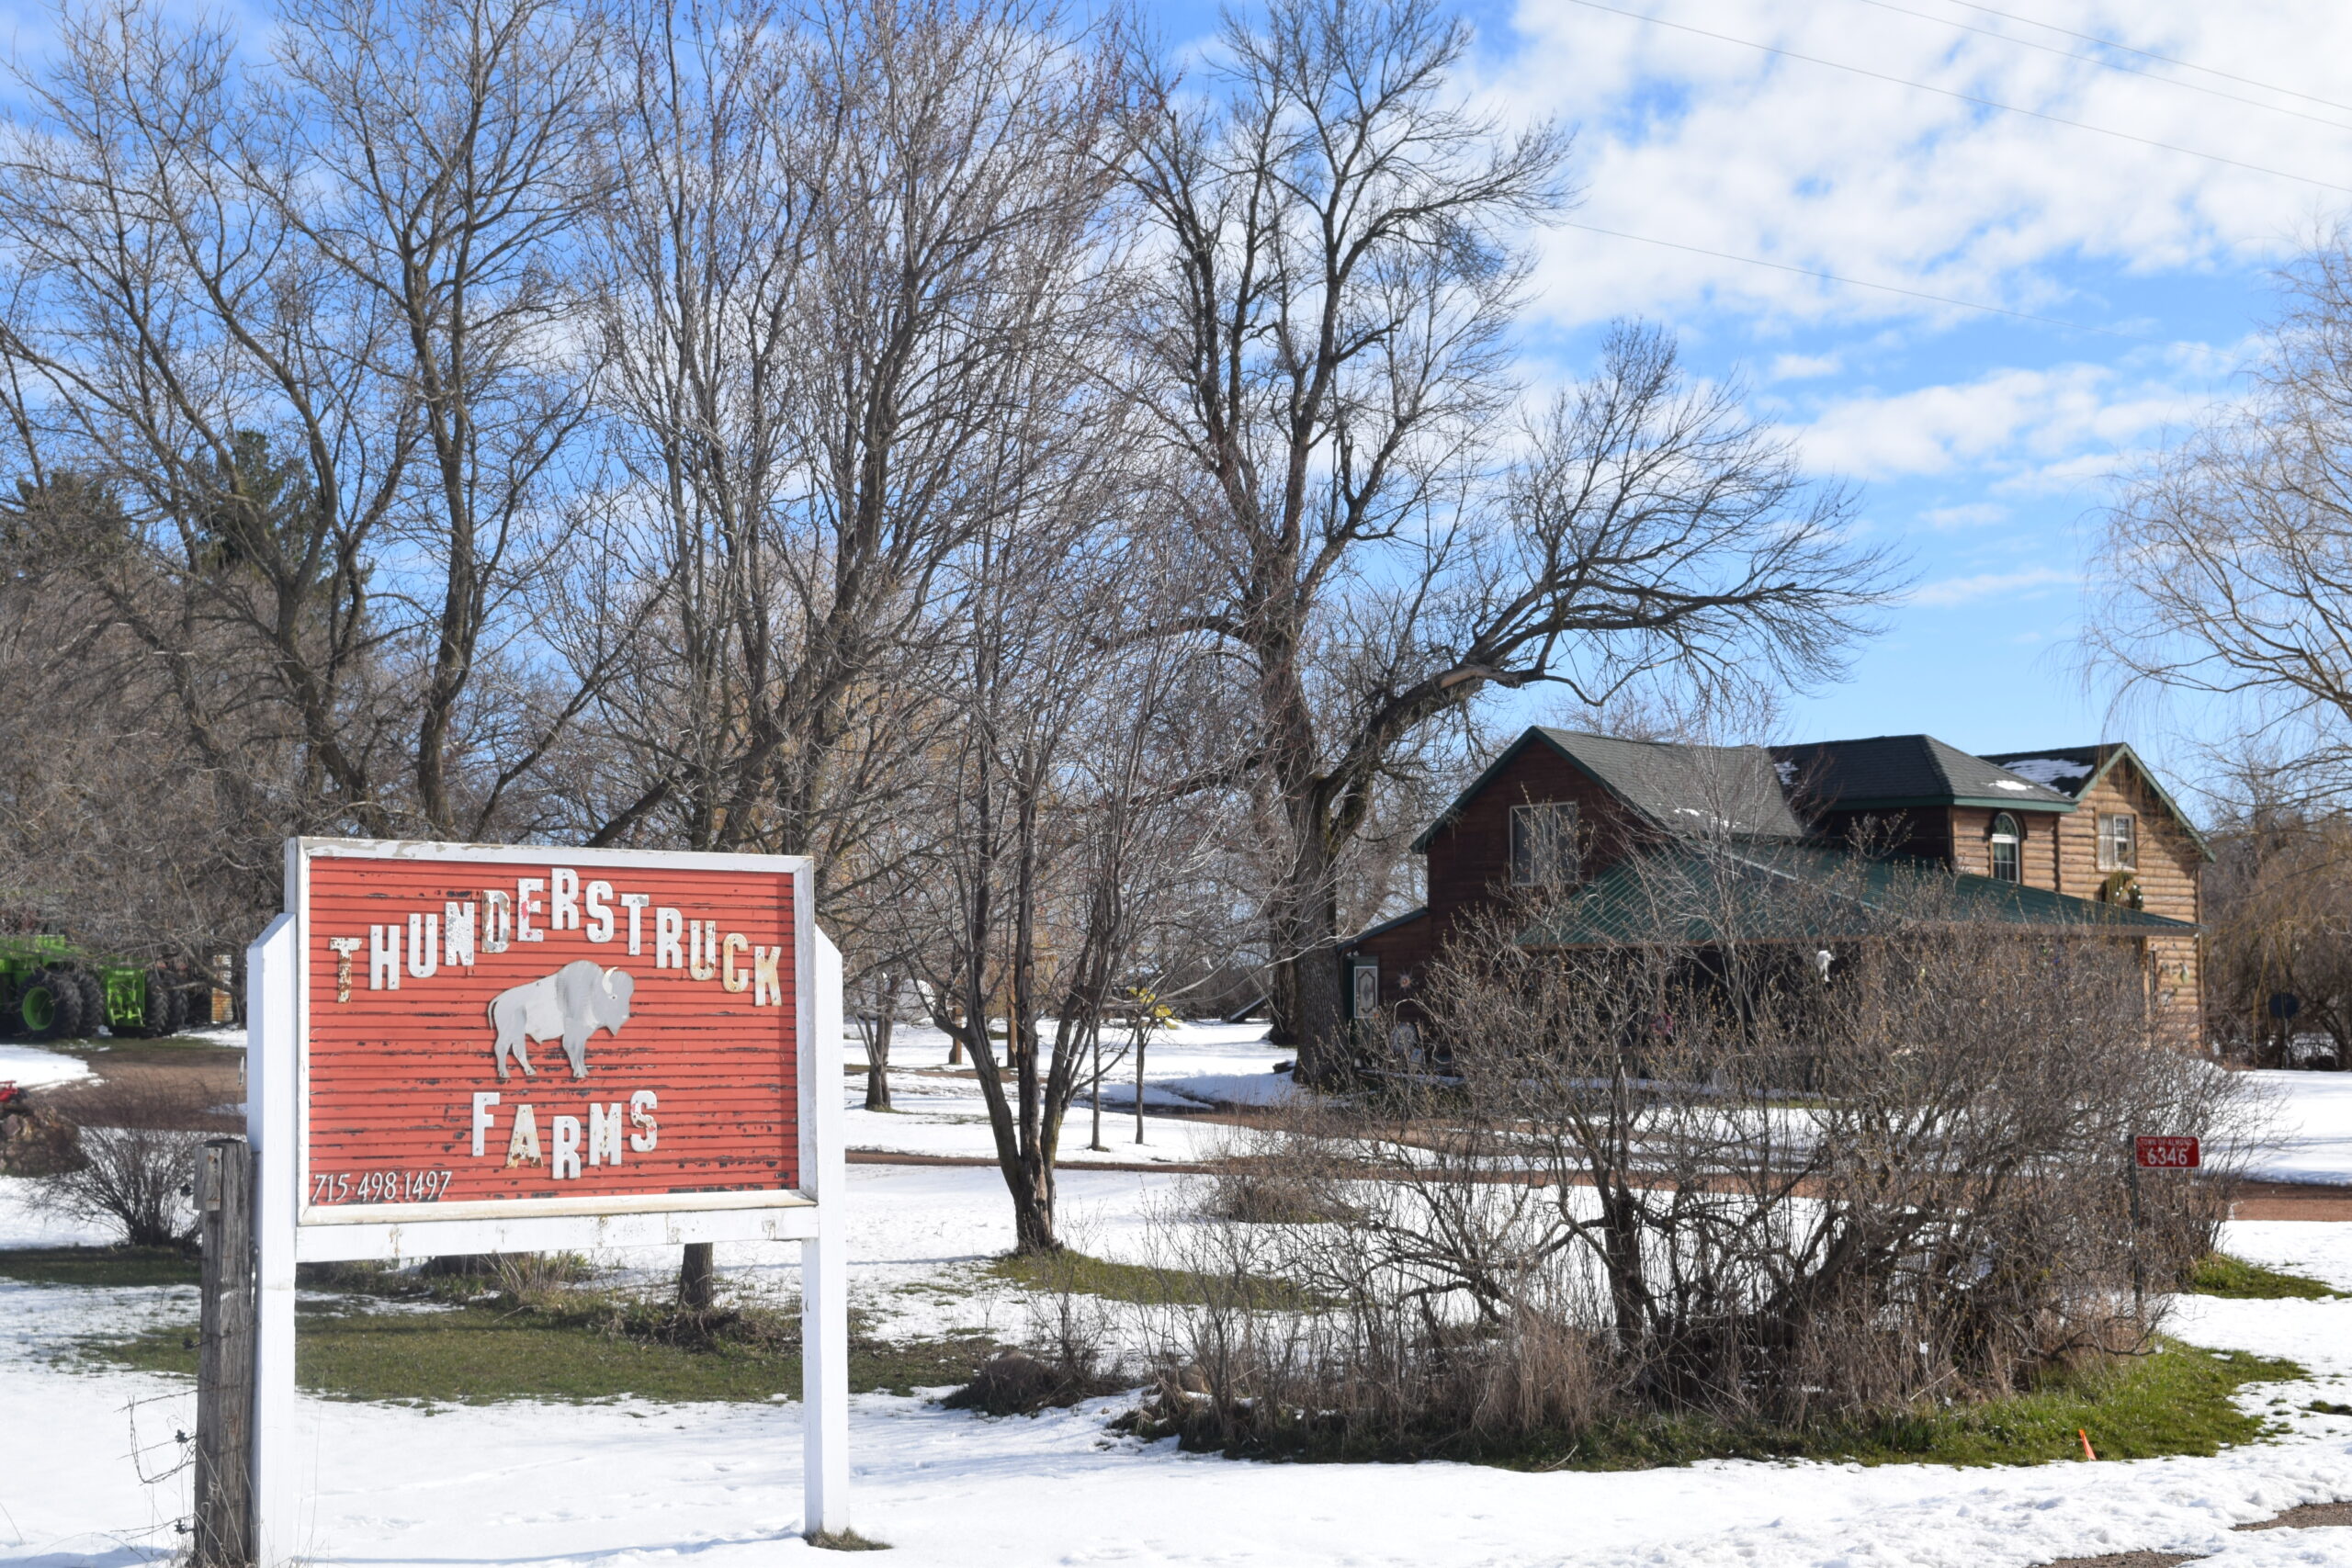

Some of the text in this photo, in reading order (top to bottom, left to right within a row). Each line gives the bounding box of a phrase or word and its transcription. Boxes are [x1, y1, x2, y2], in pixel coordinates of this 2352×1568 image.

[329, 867, 782, 1007] THUNDERSTRUCK
[471, 1090, 658, 1179] FARMS
[2147, 1146, 2188, 1166] 6346
